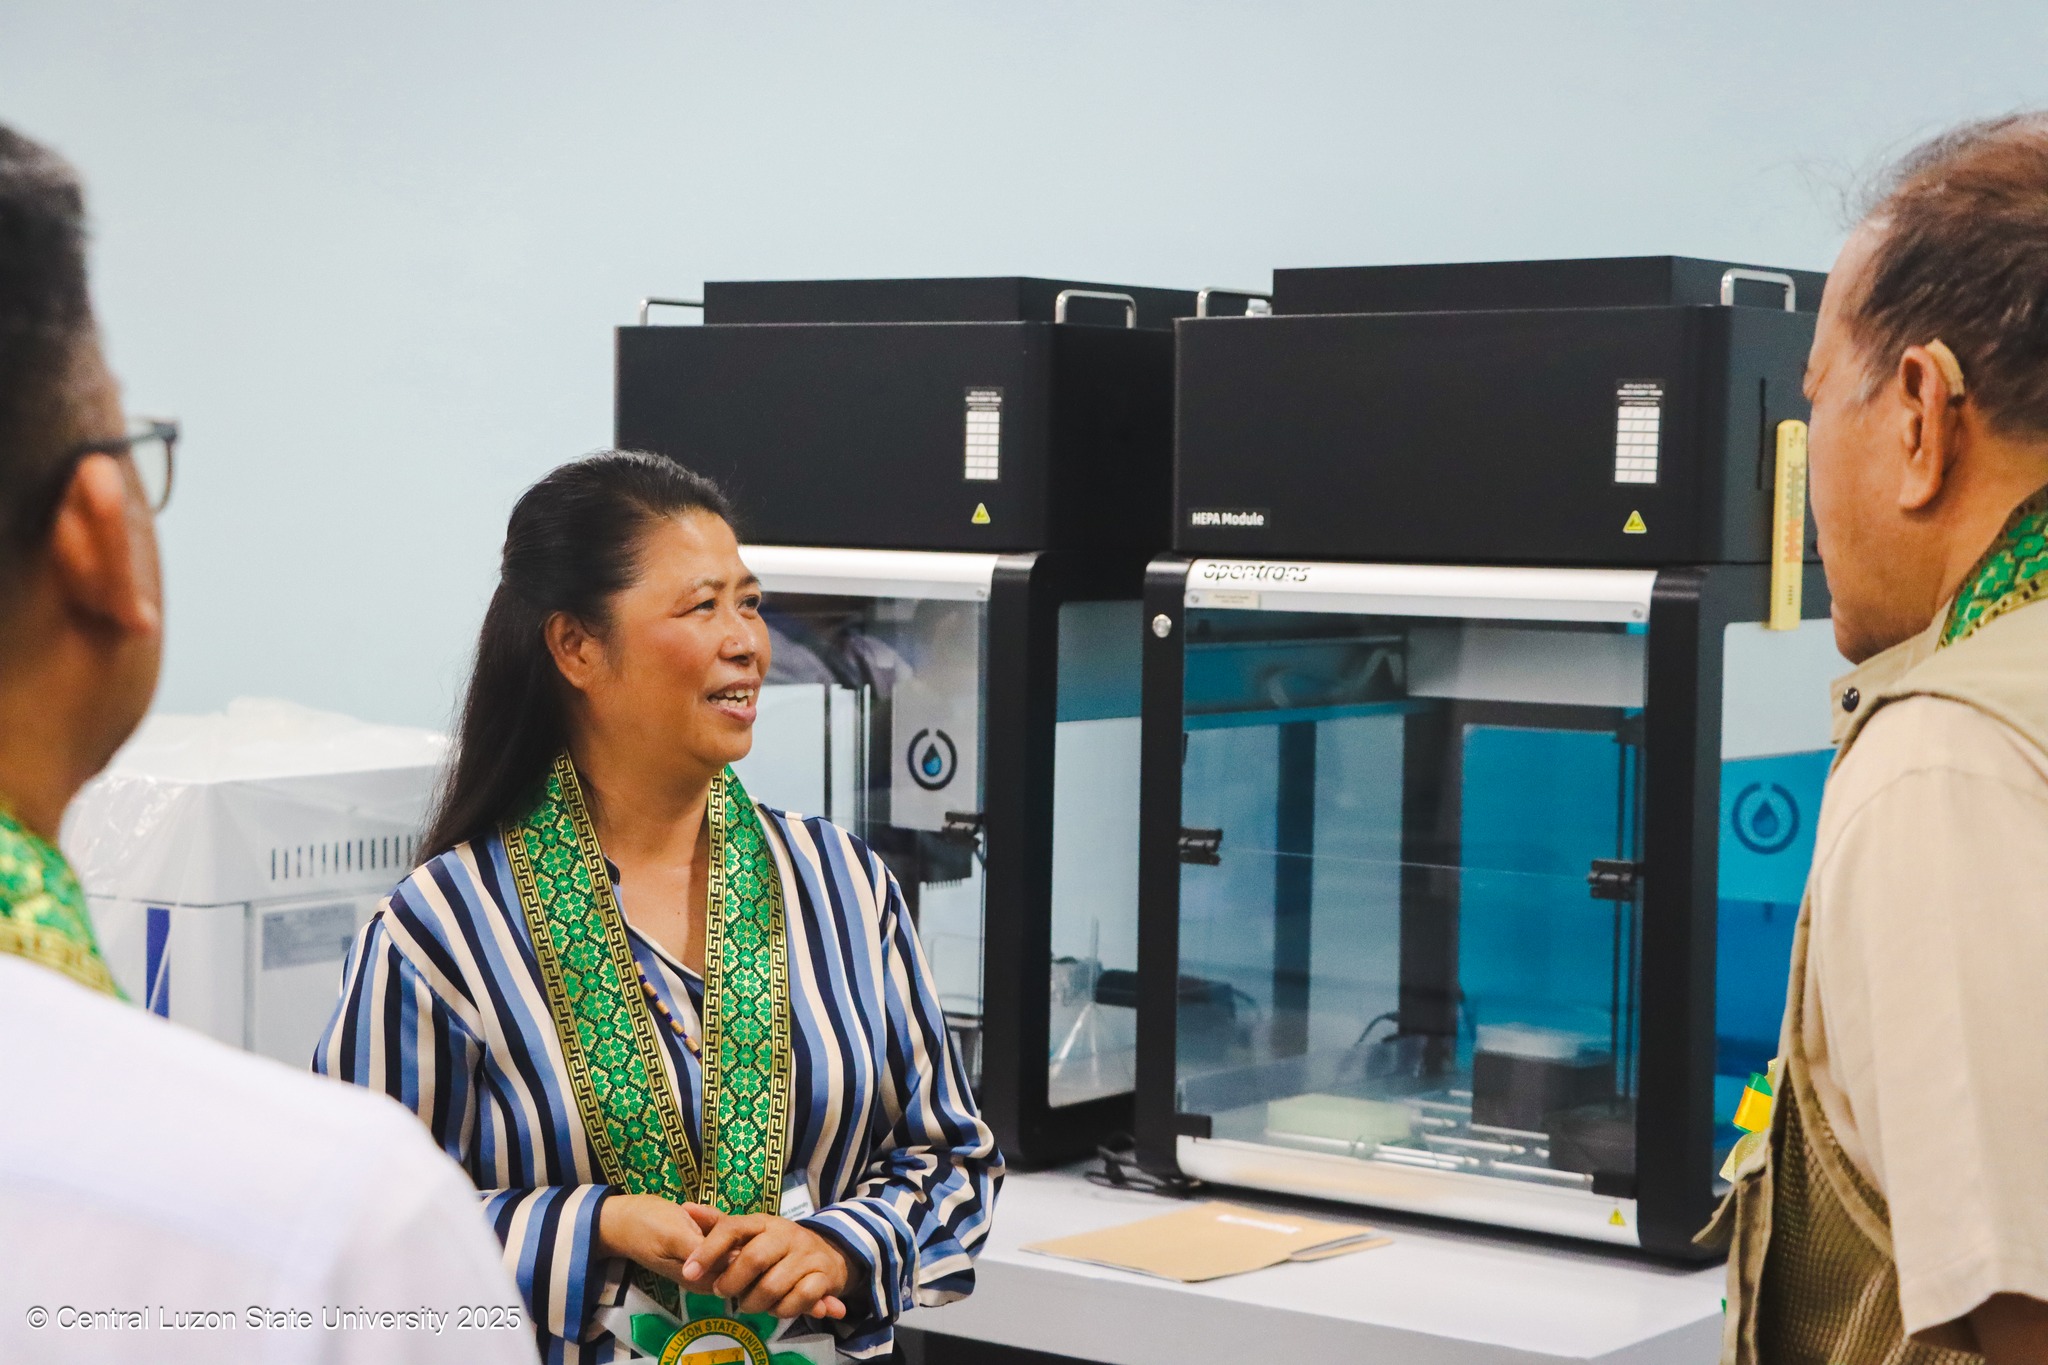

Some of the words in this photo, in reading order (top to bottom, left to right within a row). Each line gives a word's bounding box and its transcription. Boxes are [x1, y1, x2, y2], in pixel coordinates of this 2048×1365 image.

[1192, 512, 1220, 525] HEPA
[1222, 512, 1264, 526] Module
[670, 1324, 704, 1353] LUZON
[705, 1320, 740, 1335] STATE
